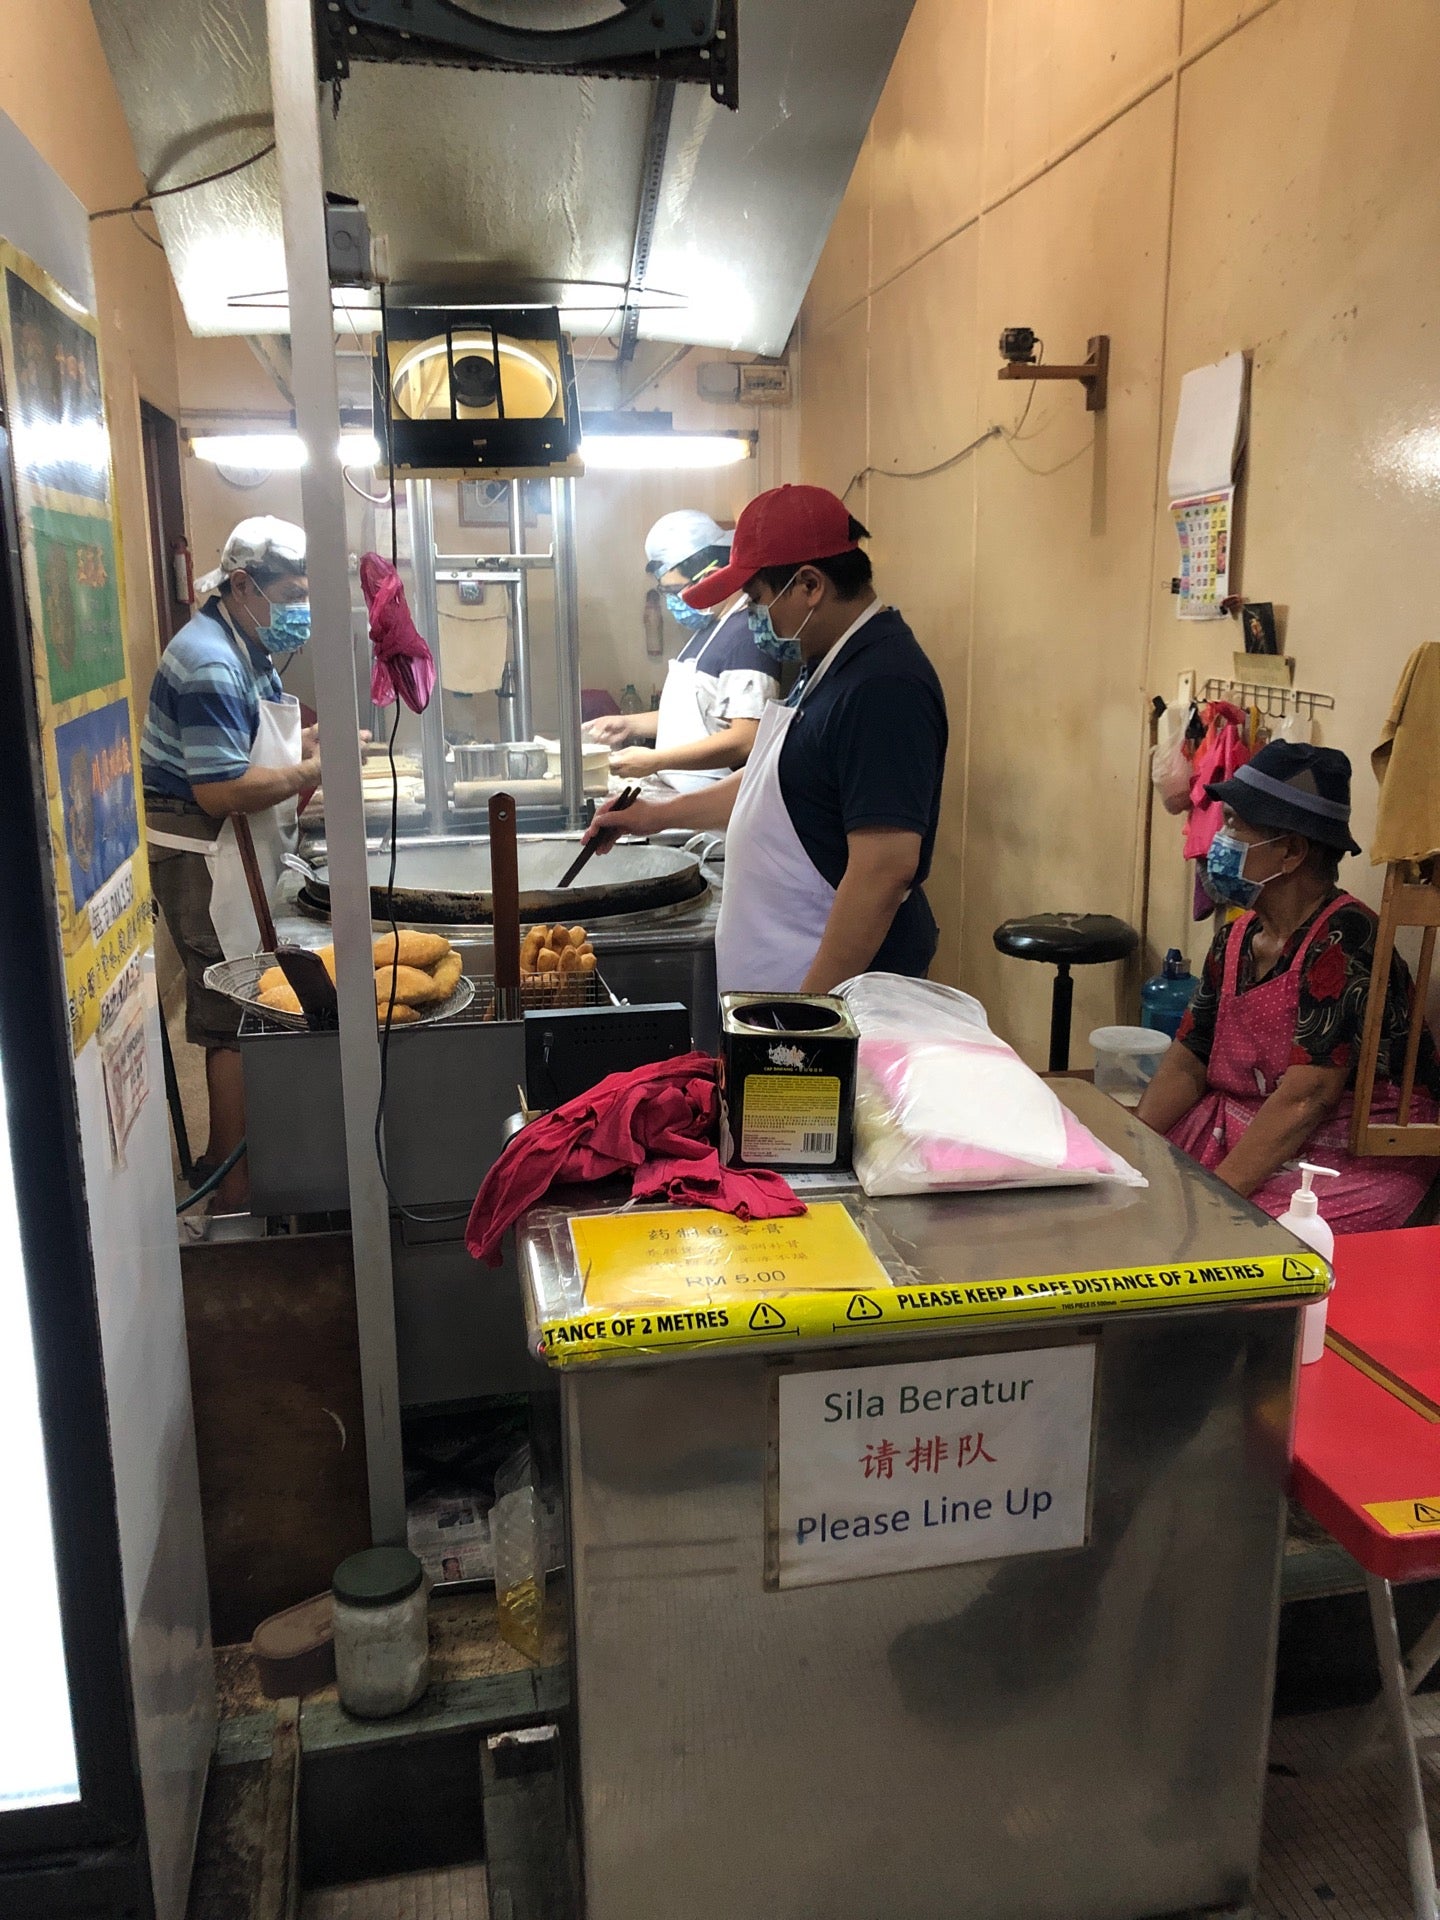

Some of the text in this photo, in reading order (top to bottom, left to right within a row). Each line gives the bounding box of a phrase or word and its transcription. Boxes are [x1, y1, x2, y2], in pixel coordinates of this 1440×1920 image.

[686, 1270, 786, 1288] RM 5.00
[897, 1264, 1265, 1310] PLEASE KEEP A SAFE DISTANCE OF 2 METRES
[544, 1310, 729, 1346] TANCE OF 2 METRES
[824, 1379, 1034, 1423] Sila Beratur
[859, 1432, 997, 1480] 请排队
[797, 1487, 1053, 1545] Please Line Up
